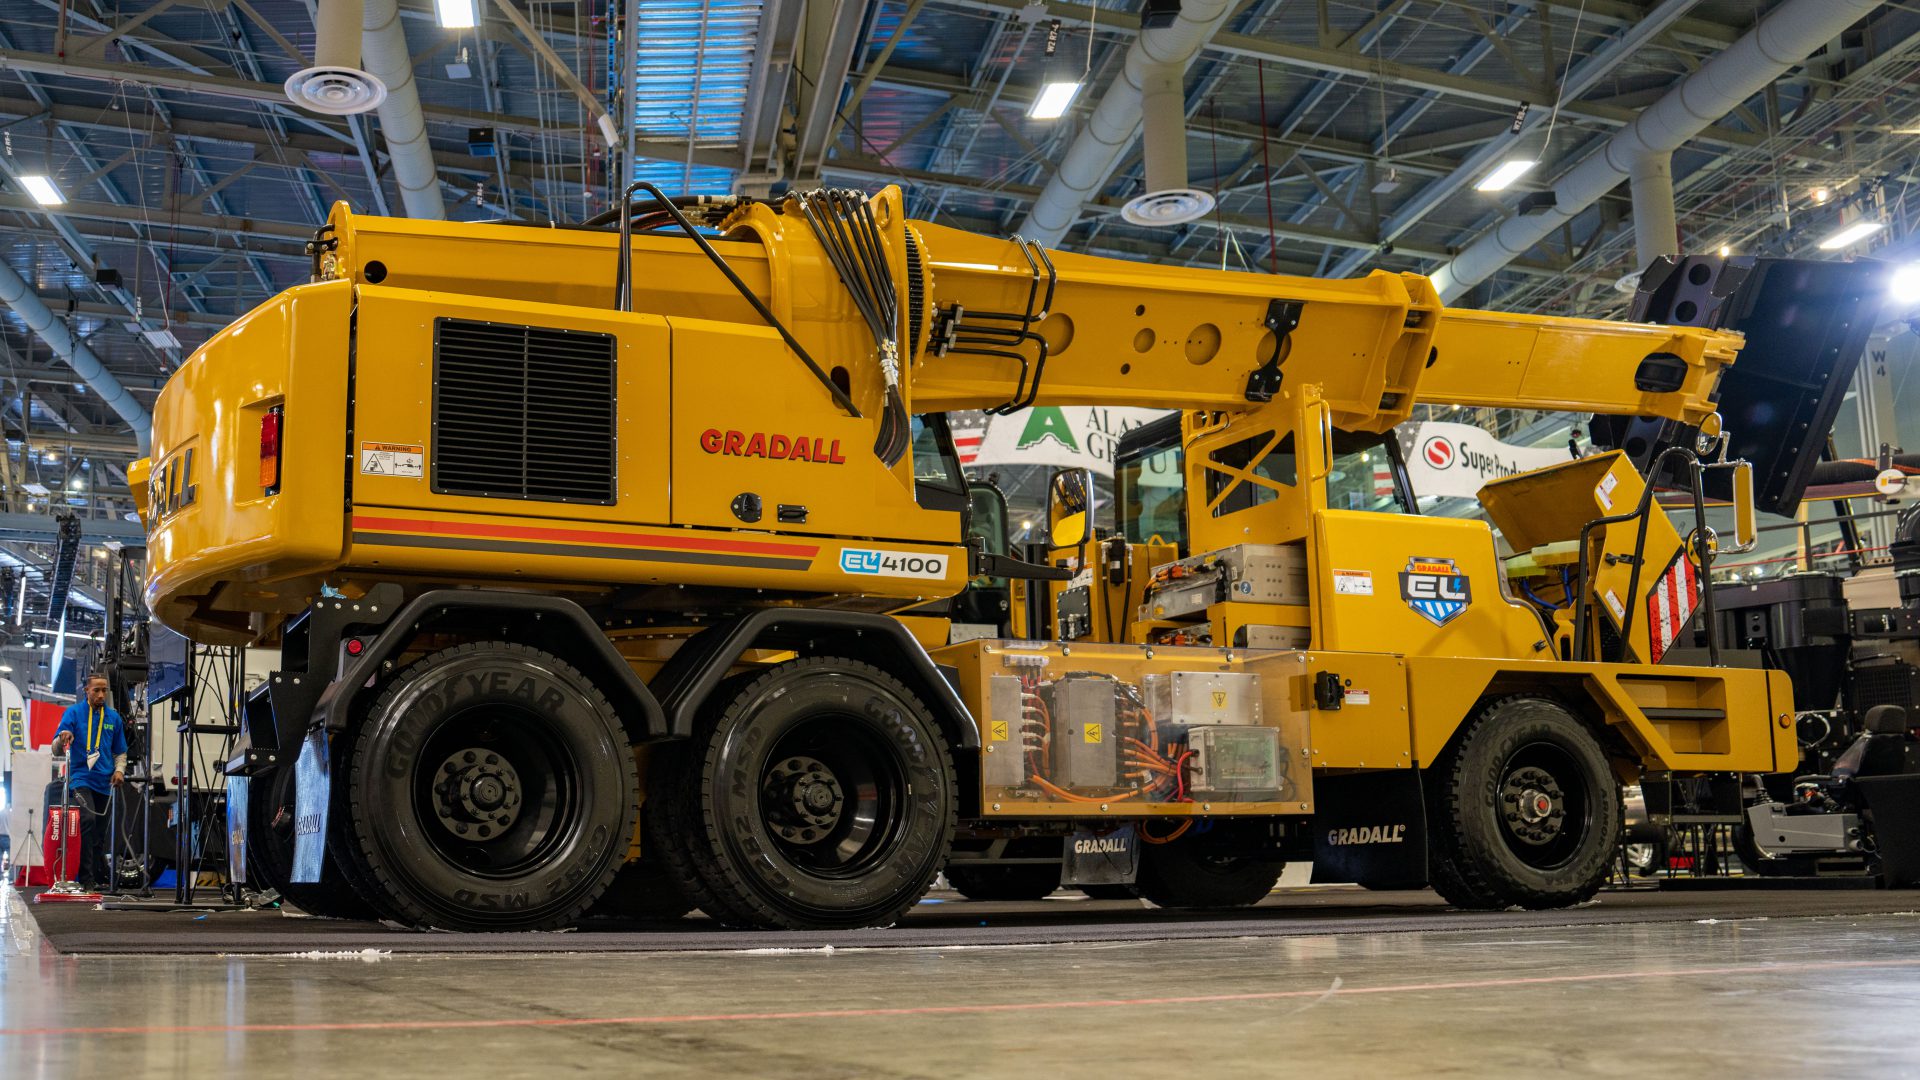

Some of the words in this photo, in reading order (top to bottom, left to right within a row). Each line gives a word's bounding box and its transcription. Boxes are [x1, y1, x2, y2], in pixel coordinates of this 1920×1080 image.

[1871, 350, 1886, 363] W
[1876, 365, 1887, 377] 4
[700, 428, 847, 465] GRADALL
[881, 556, 942, 574] 4100
[1416, 564, 1450, 574] GRADALL
[1407, 574, 1466, 600] EL
[1074, 838, 1127, 854] GRADALL
